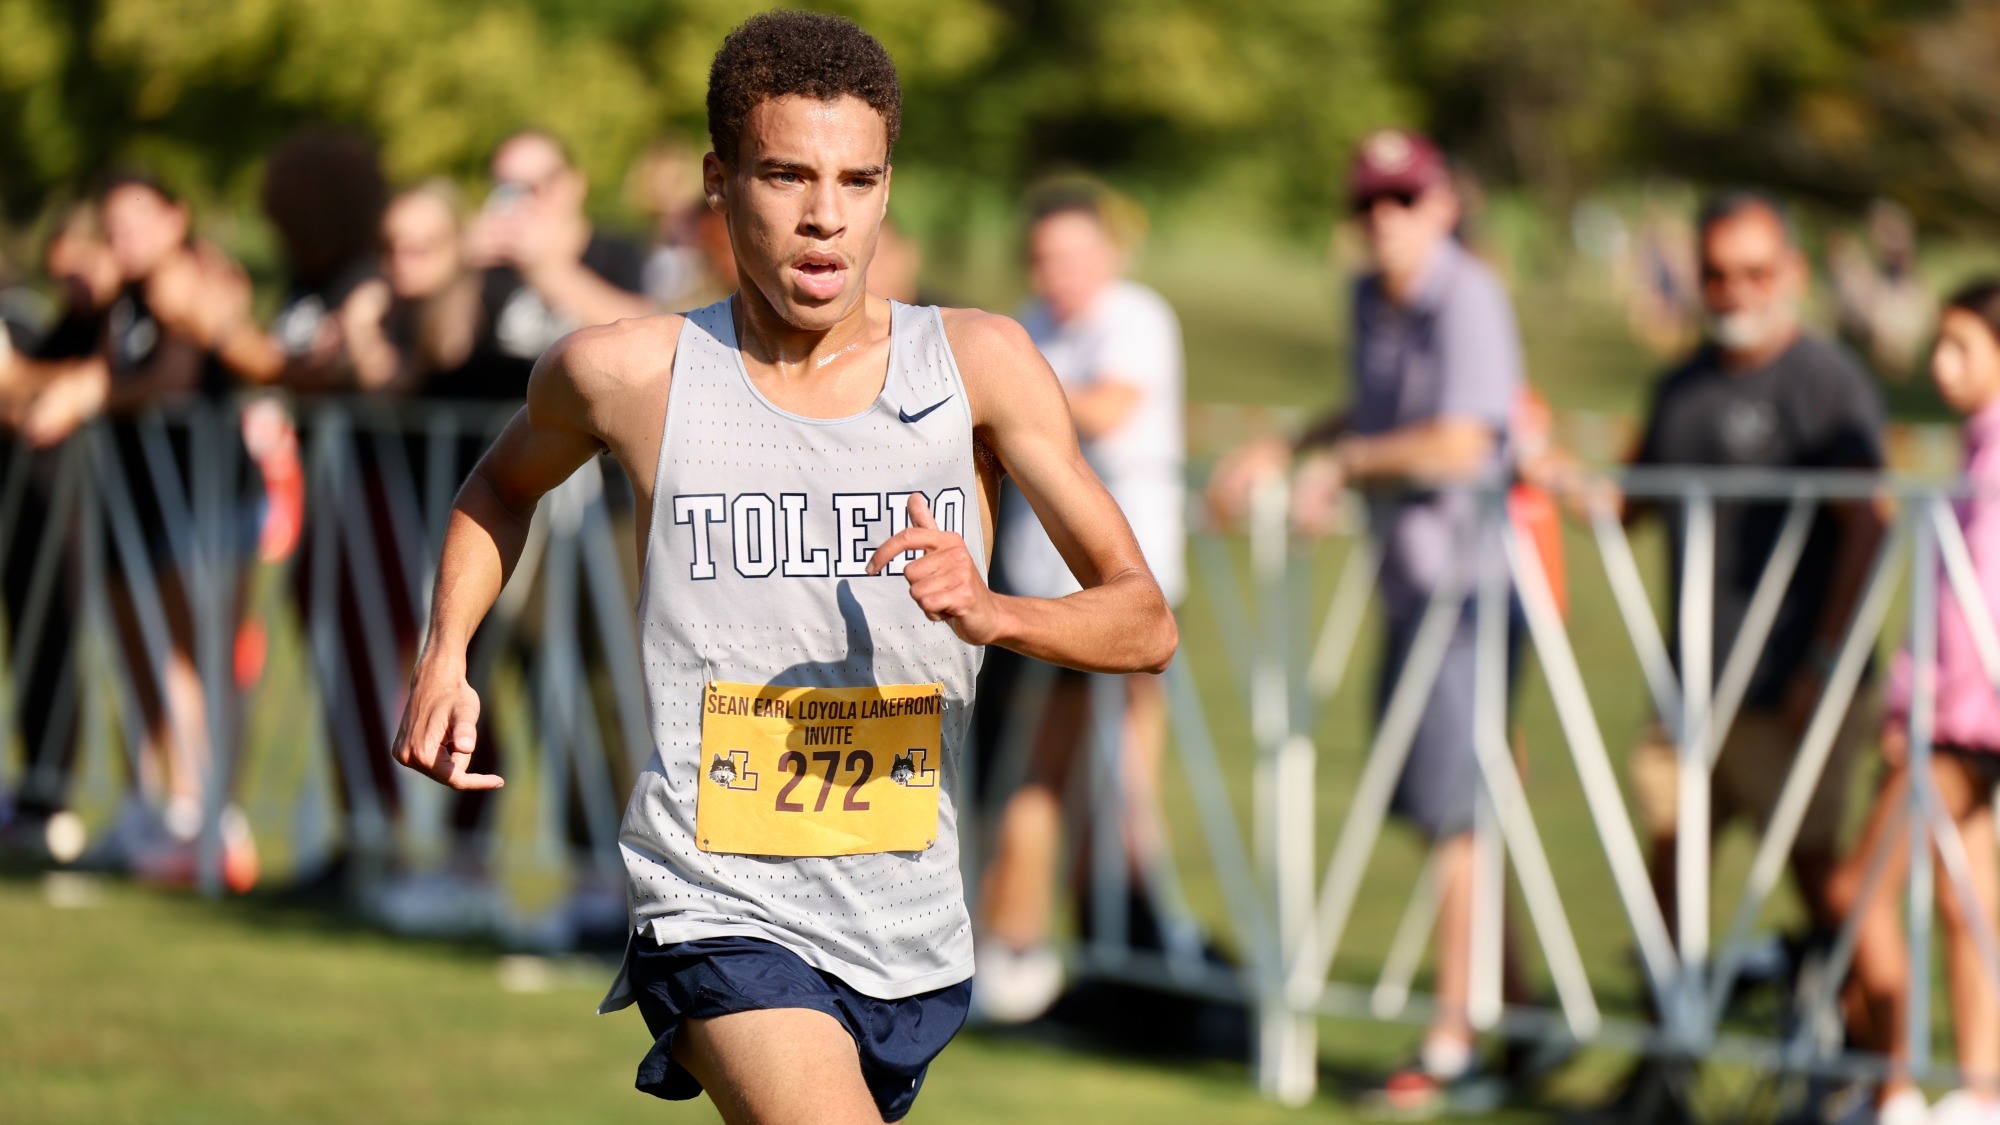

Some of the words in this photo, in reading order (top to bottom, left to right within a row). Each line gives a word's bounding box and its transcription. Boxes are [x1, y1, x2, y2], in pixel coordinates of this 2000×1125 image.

[707, 693, 749, 716] SEAN
[753, 697, 794, 719] EARL
[798, 700, 857, 720] LOYOLA
[861, 695, 942, 719] LAKEFRONT
[804, 725, 854, 746] INVITE
[775, 750, 874, 813] 272
